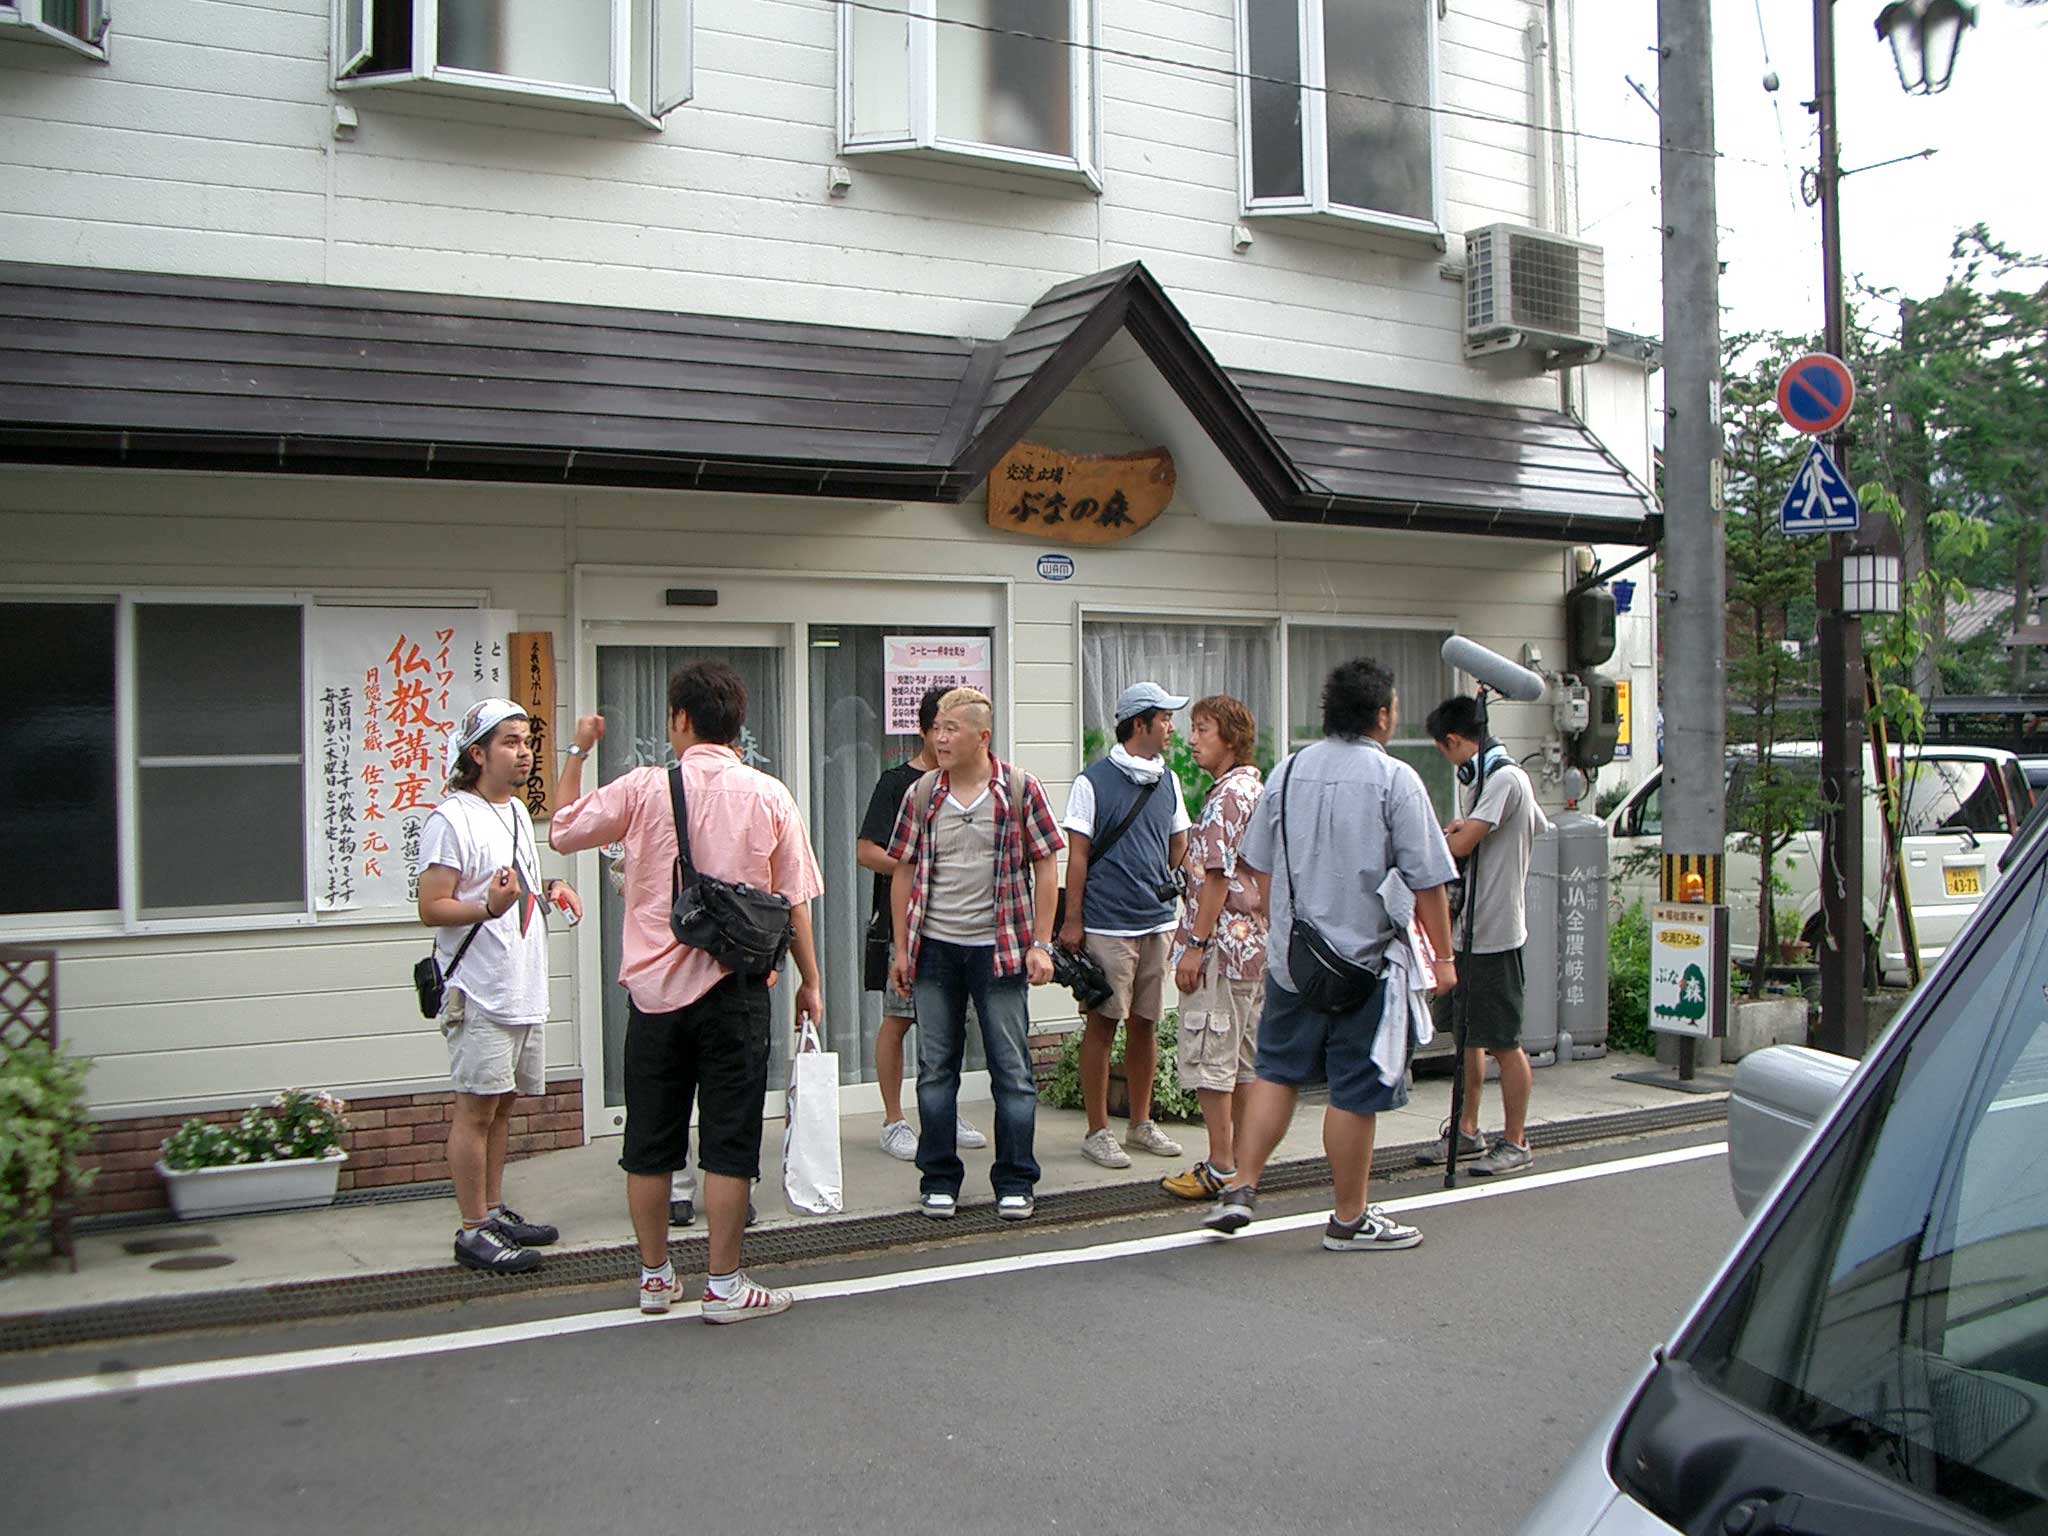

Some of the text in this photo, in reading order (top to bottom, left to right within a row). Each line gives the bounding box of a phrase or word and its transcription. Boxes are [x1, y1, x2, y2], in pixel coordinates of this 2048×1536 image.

[1006, 463, 1065, 484] 交流広場
[1009, 489, 1136, 528] ぶなの森
[1042, 564, 1070, 574] WAM
[473, 640, 484, 683] ところ
[384, 633, 438, 812] 仏教講座
